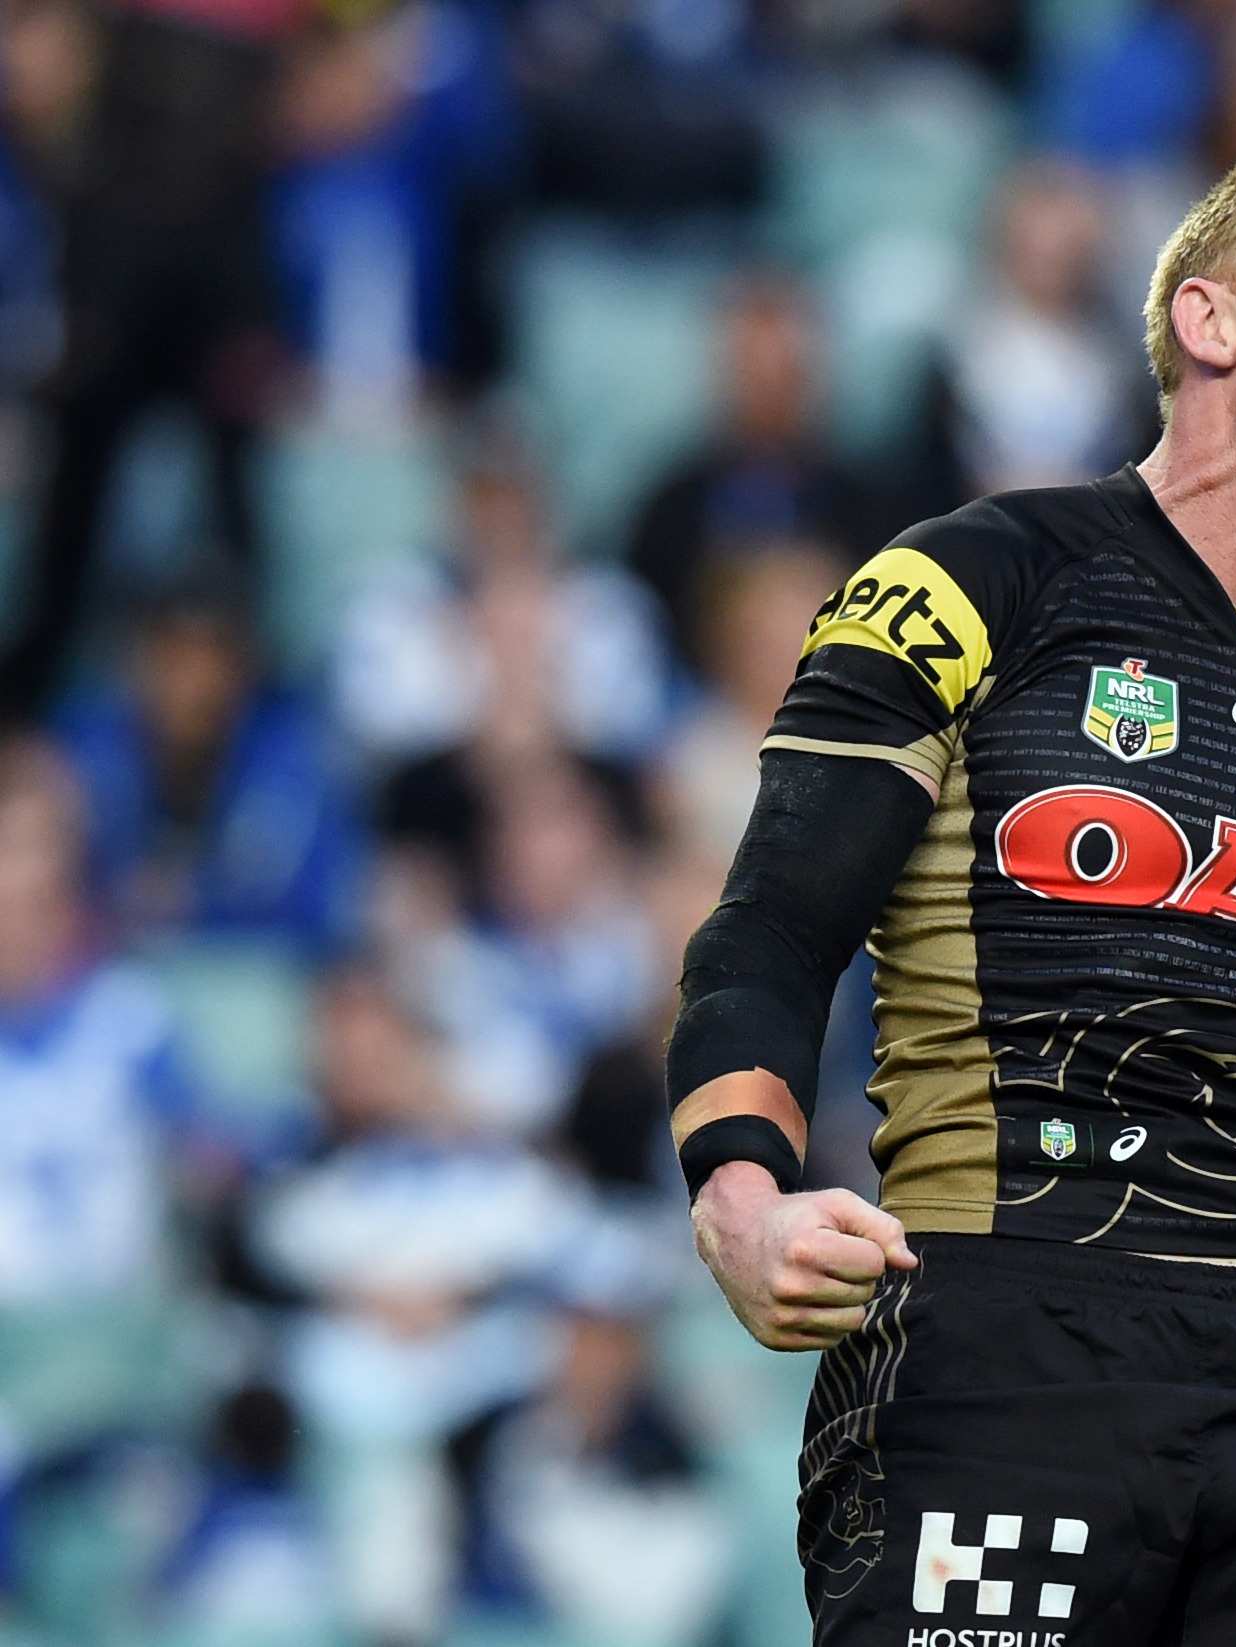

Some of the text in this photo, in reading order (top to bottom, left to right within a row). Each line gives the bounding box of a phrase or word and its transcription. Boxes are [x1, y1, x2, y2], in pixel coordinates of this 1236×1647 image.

[1107, 677, 1166, 706] NRL
[1101, 702, 1166, 720] PREMIERSHIP
[1115, 698, 1156, 712] TELSTRA
[907, 1627, 1067, 1647] HOSTPLUS
